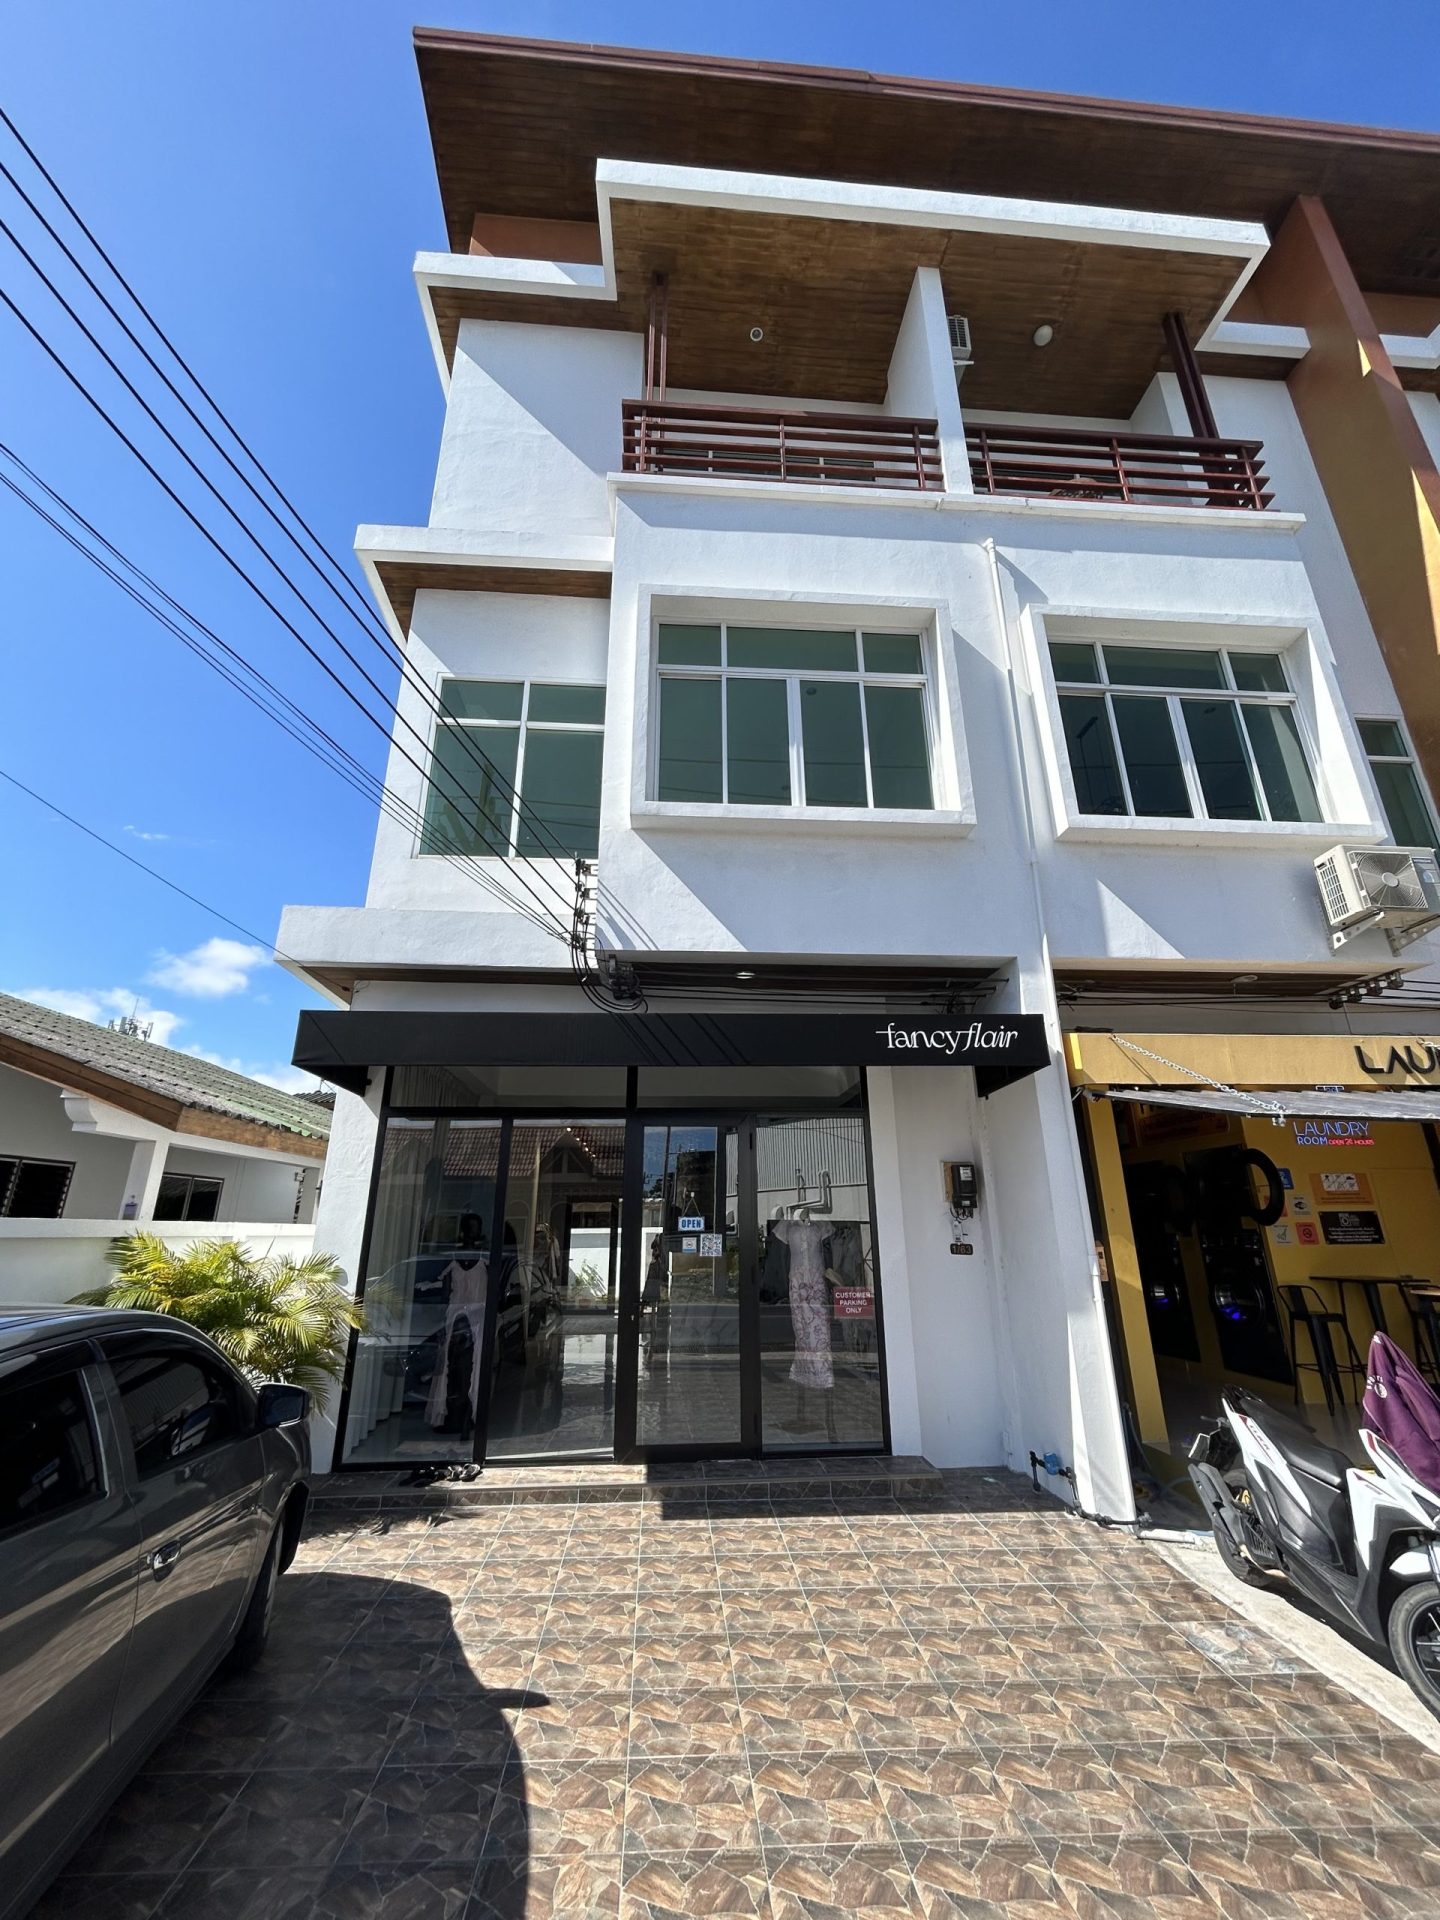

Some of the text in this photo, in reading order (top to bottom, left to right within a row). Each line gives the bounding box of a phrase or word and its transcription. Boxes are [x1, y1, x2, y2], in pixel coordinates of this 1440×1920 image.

[875, 1022, 1019, 1055] fancyflair
[1354, 1046, 1440, 1074] LAU
[1293, 1121, 1369, 1136] LAUNDRY
[1297, 1136, 1328, 1145] ROOM
[681, 1219, 702, 1229] OPEN
